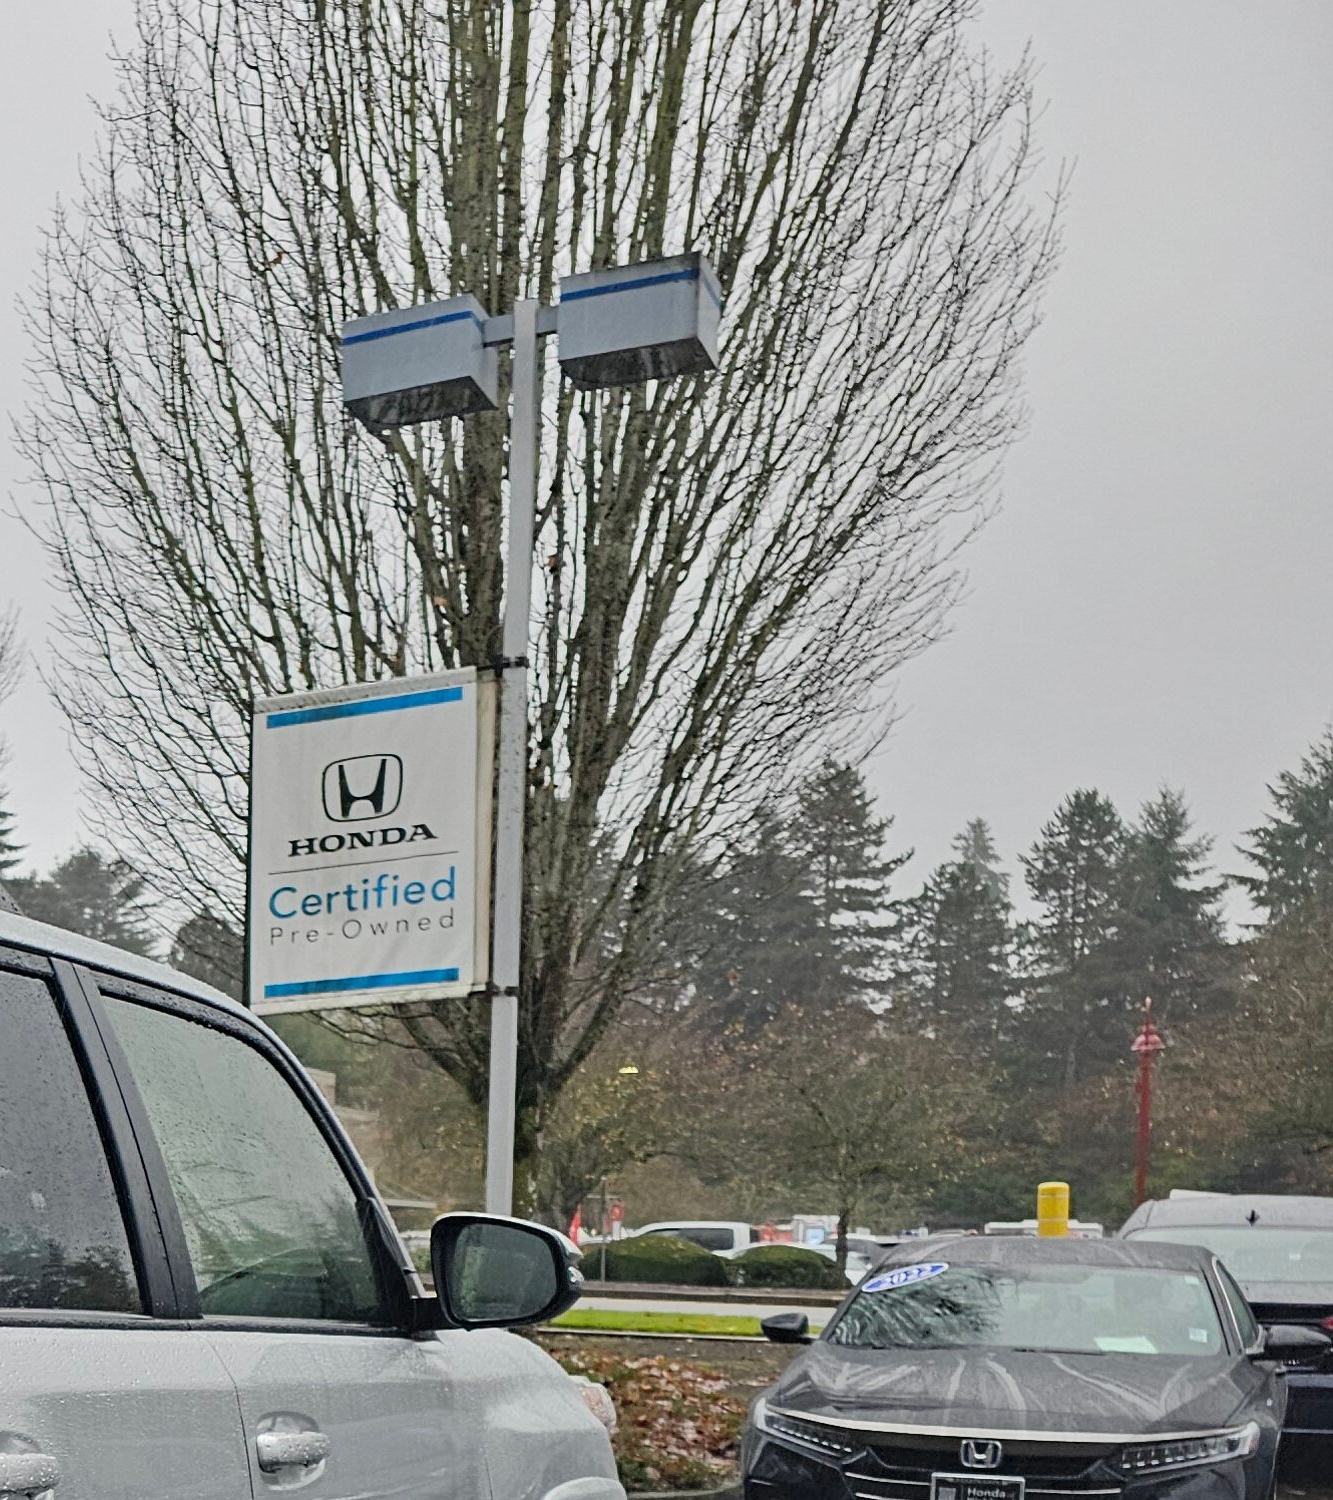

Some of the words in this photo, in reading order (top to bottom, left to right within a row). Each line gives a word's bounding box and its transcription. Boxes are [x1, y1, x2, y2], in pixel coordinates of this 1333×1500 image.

[288, 824, 438, 857] HONDA
[269, 865, 457, 920] Certified
[270, 907, 455, 945] Pre-Owned
[968, 1487, 1006, 1498] Honda
